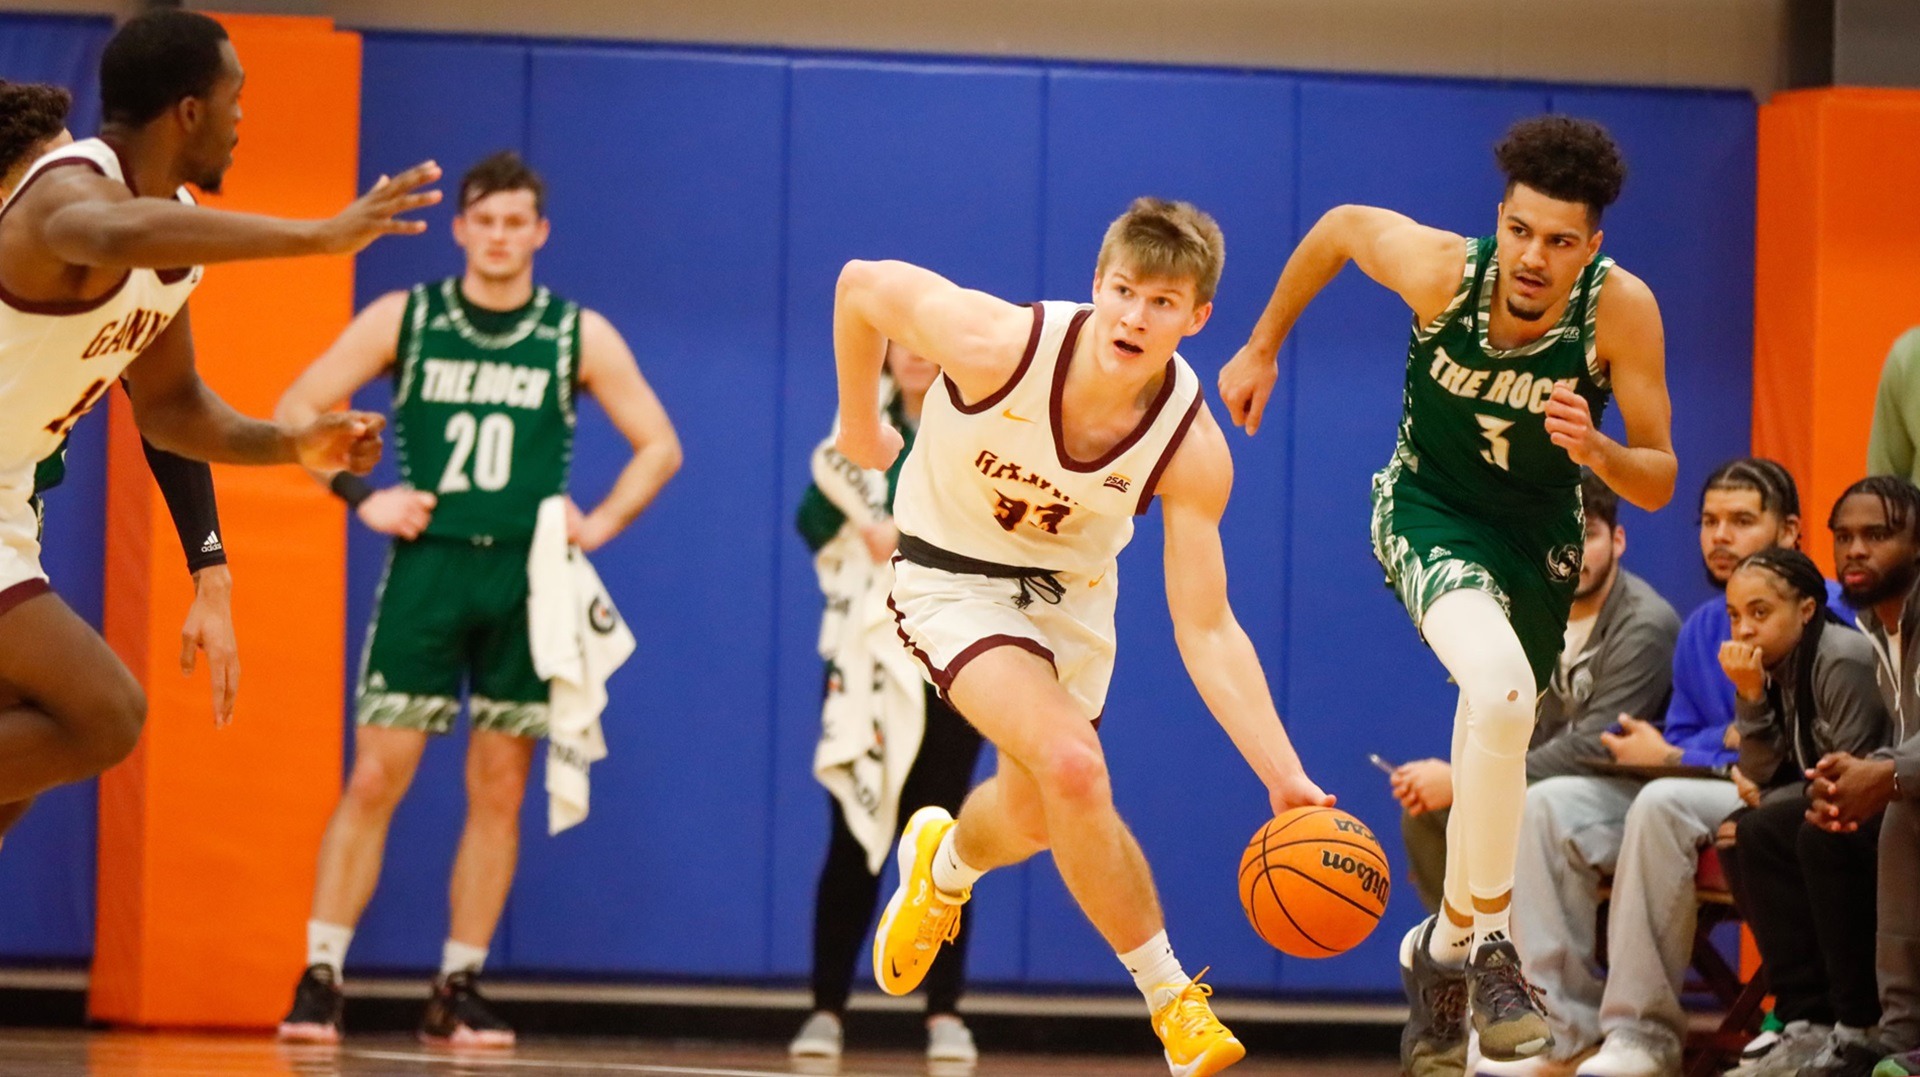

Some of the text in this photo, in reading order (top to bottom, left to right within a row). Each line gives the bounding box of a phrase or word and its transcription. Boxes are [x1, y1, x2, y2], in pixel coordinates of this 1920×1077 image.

[421, 358, 550, 411] THE ROCK
[1429, 346, 1492, 399] THE
[437, 411, 515, 493] 20
[1474, 413, 1516, 472] 3
[1104, 475, 1131, 491] PSAC
[1333, 817, 1379, 846] CAA
[1322, 850, 1389, 908] Wilson
